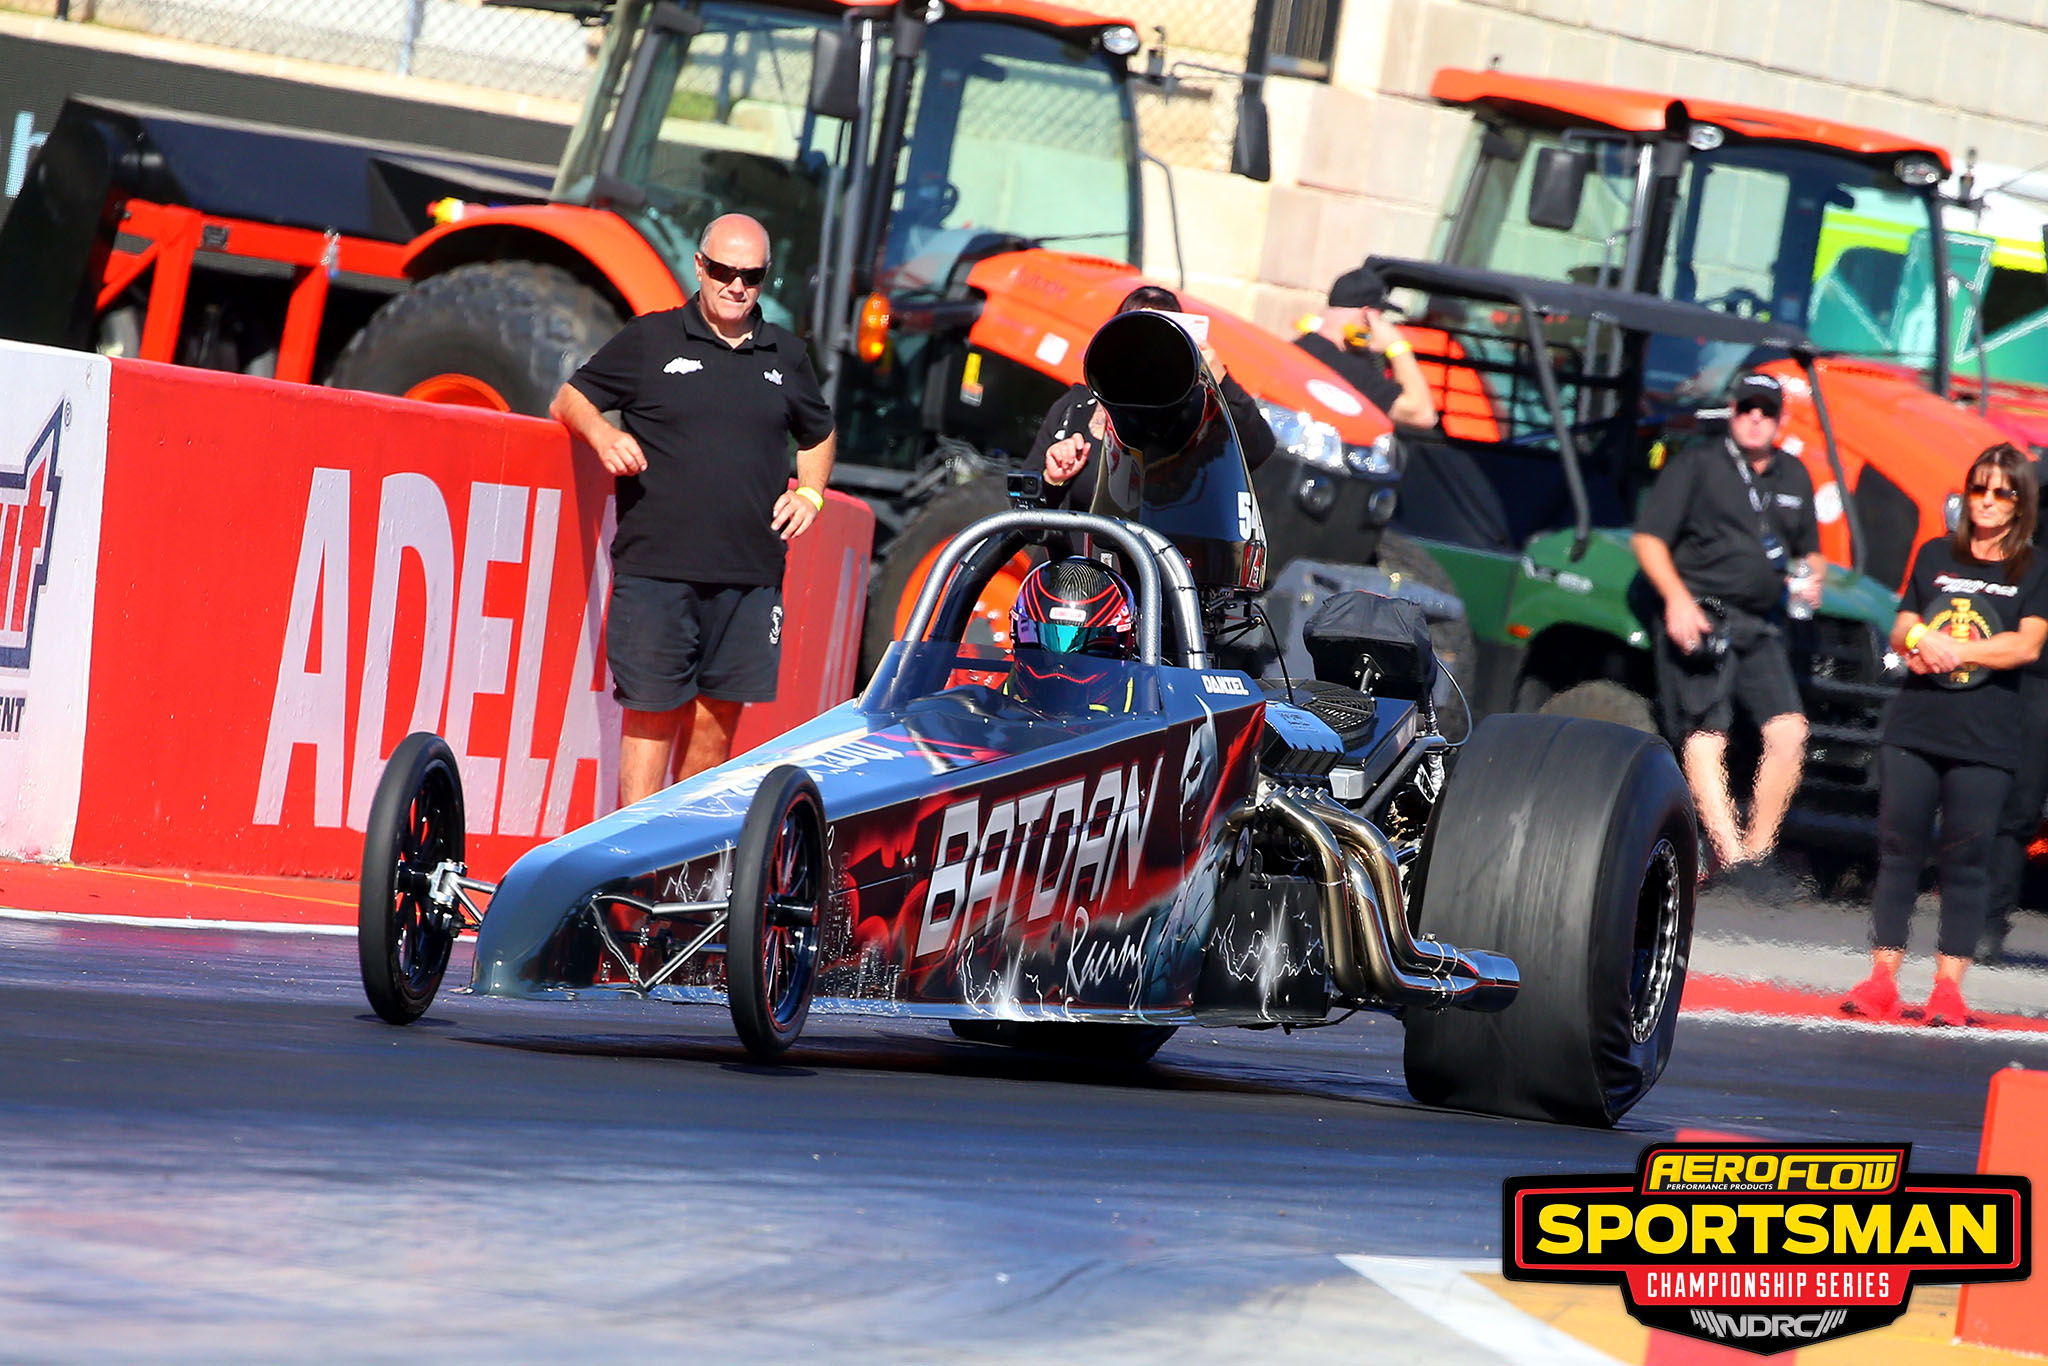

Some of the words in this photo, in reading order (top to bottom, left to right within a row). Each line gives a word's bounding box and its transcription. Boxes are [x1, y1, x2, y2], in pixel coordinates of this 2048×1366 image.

[0, 697, 26, 734] NT
[1201, 675, 1250, 696] DANIEL
[915, 755, 1165, 960] BATDAN
[1064, 905, 1152, 1011] Racing
